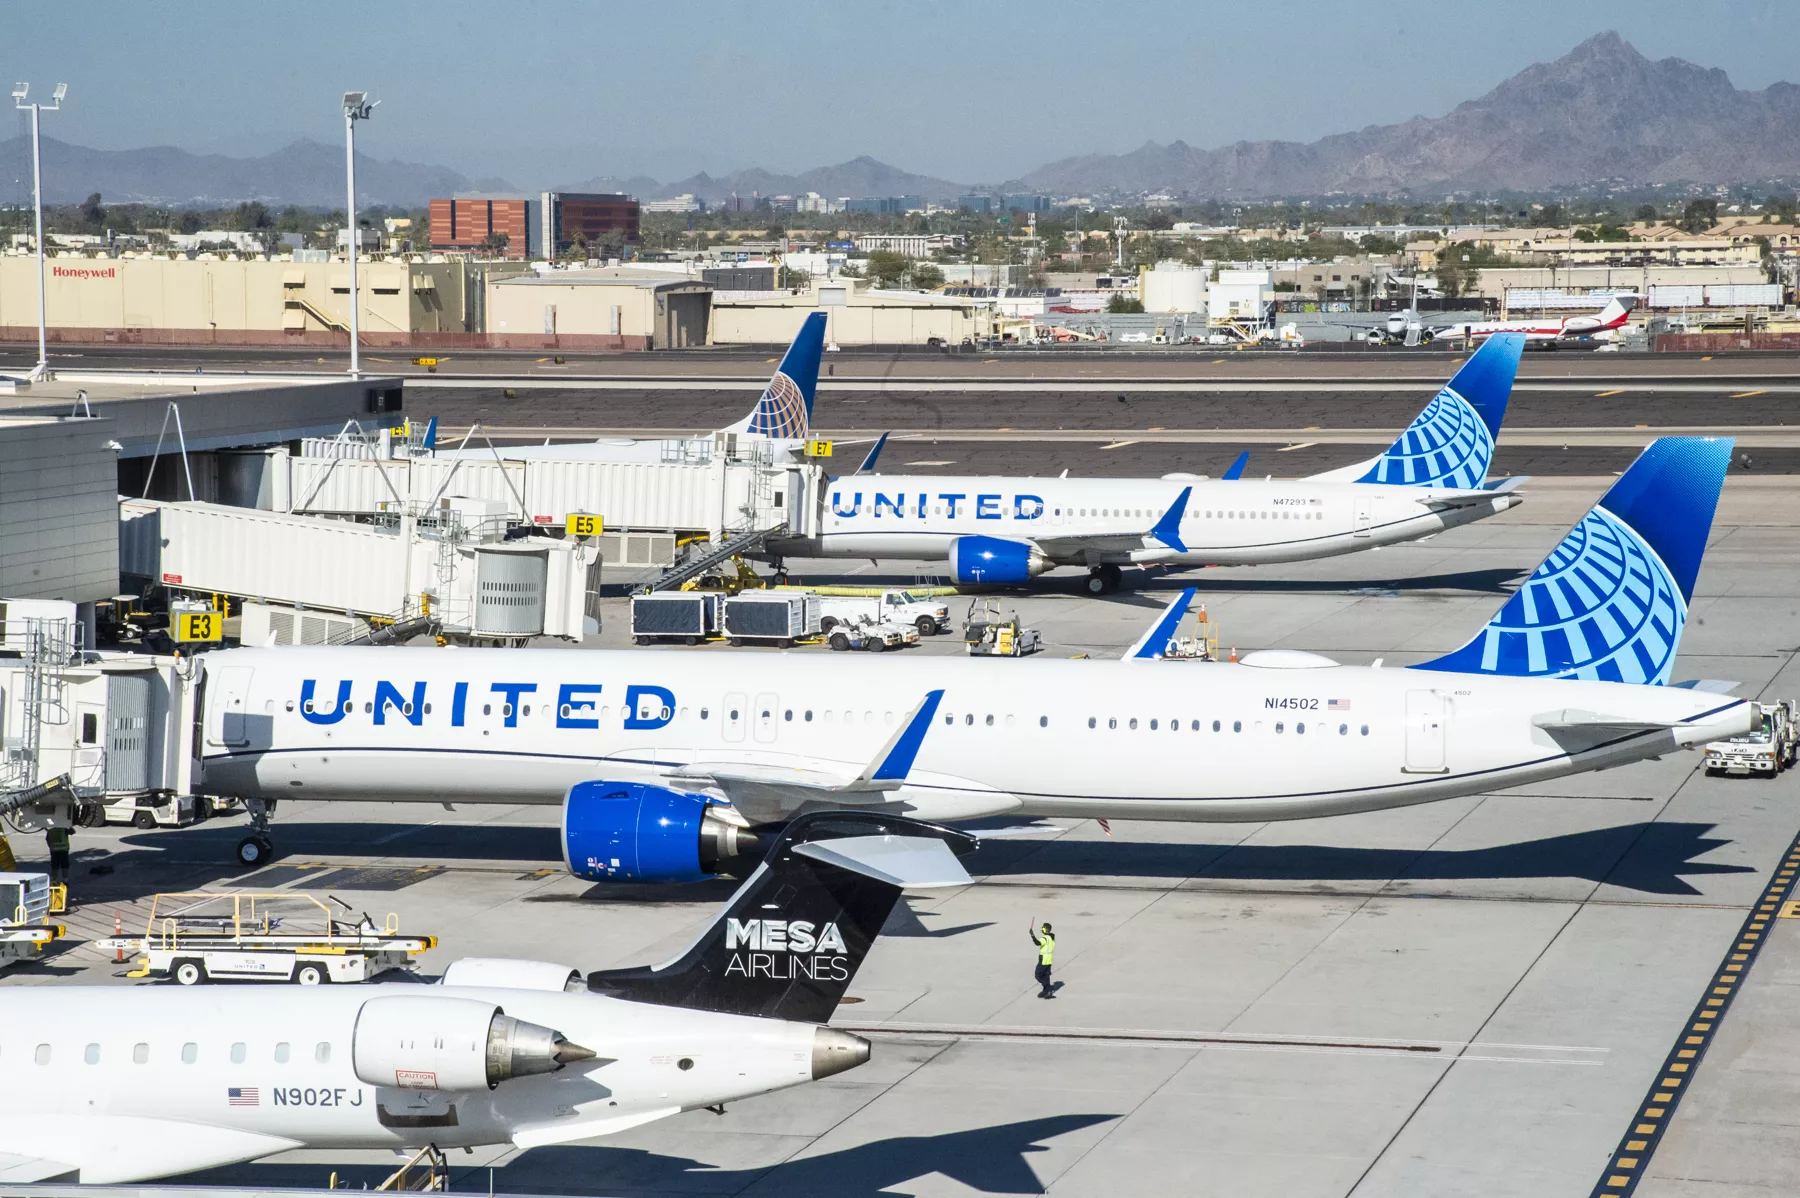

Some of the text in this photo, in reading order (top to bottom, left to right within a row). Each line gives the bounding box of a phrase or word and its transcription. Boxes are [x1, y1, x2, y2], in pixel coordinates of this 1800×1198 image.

[53, 266, 115, 280] Honeywell
[817, 442, 827, 455] E7
[832, 492, 1045, 520] UNITED
[1273, 498, 1306, 506] N47293
[576, 516, 594, 533] E5
[190, 615, 211, 639] E3
[299, 679, 677, 730] UNITED
[1264, 697, 1319, 710] N14502
[725, 917, 848, 954] MESA
[724, 952, 849, 981] AIRLINES
[398, 1072, 434, 1080] CAUTION
[273, 1087, 363, 1107] N902FJ
